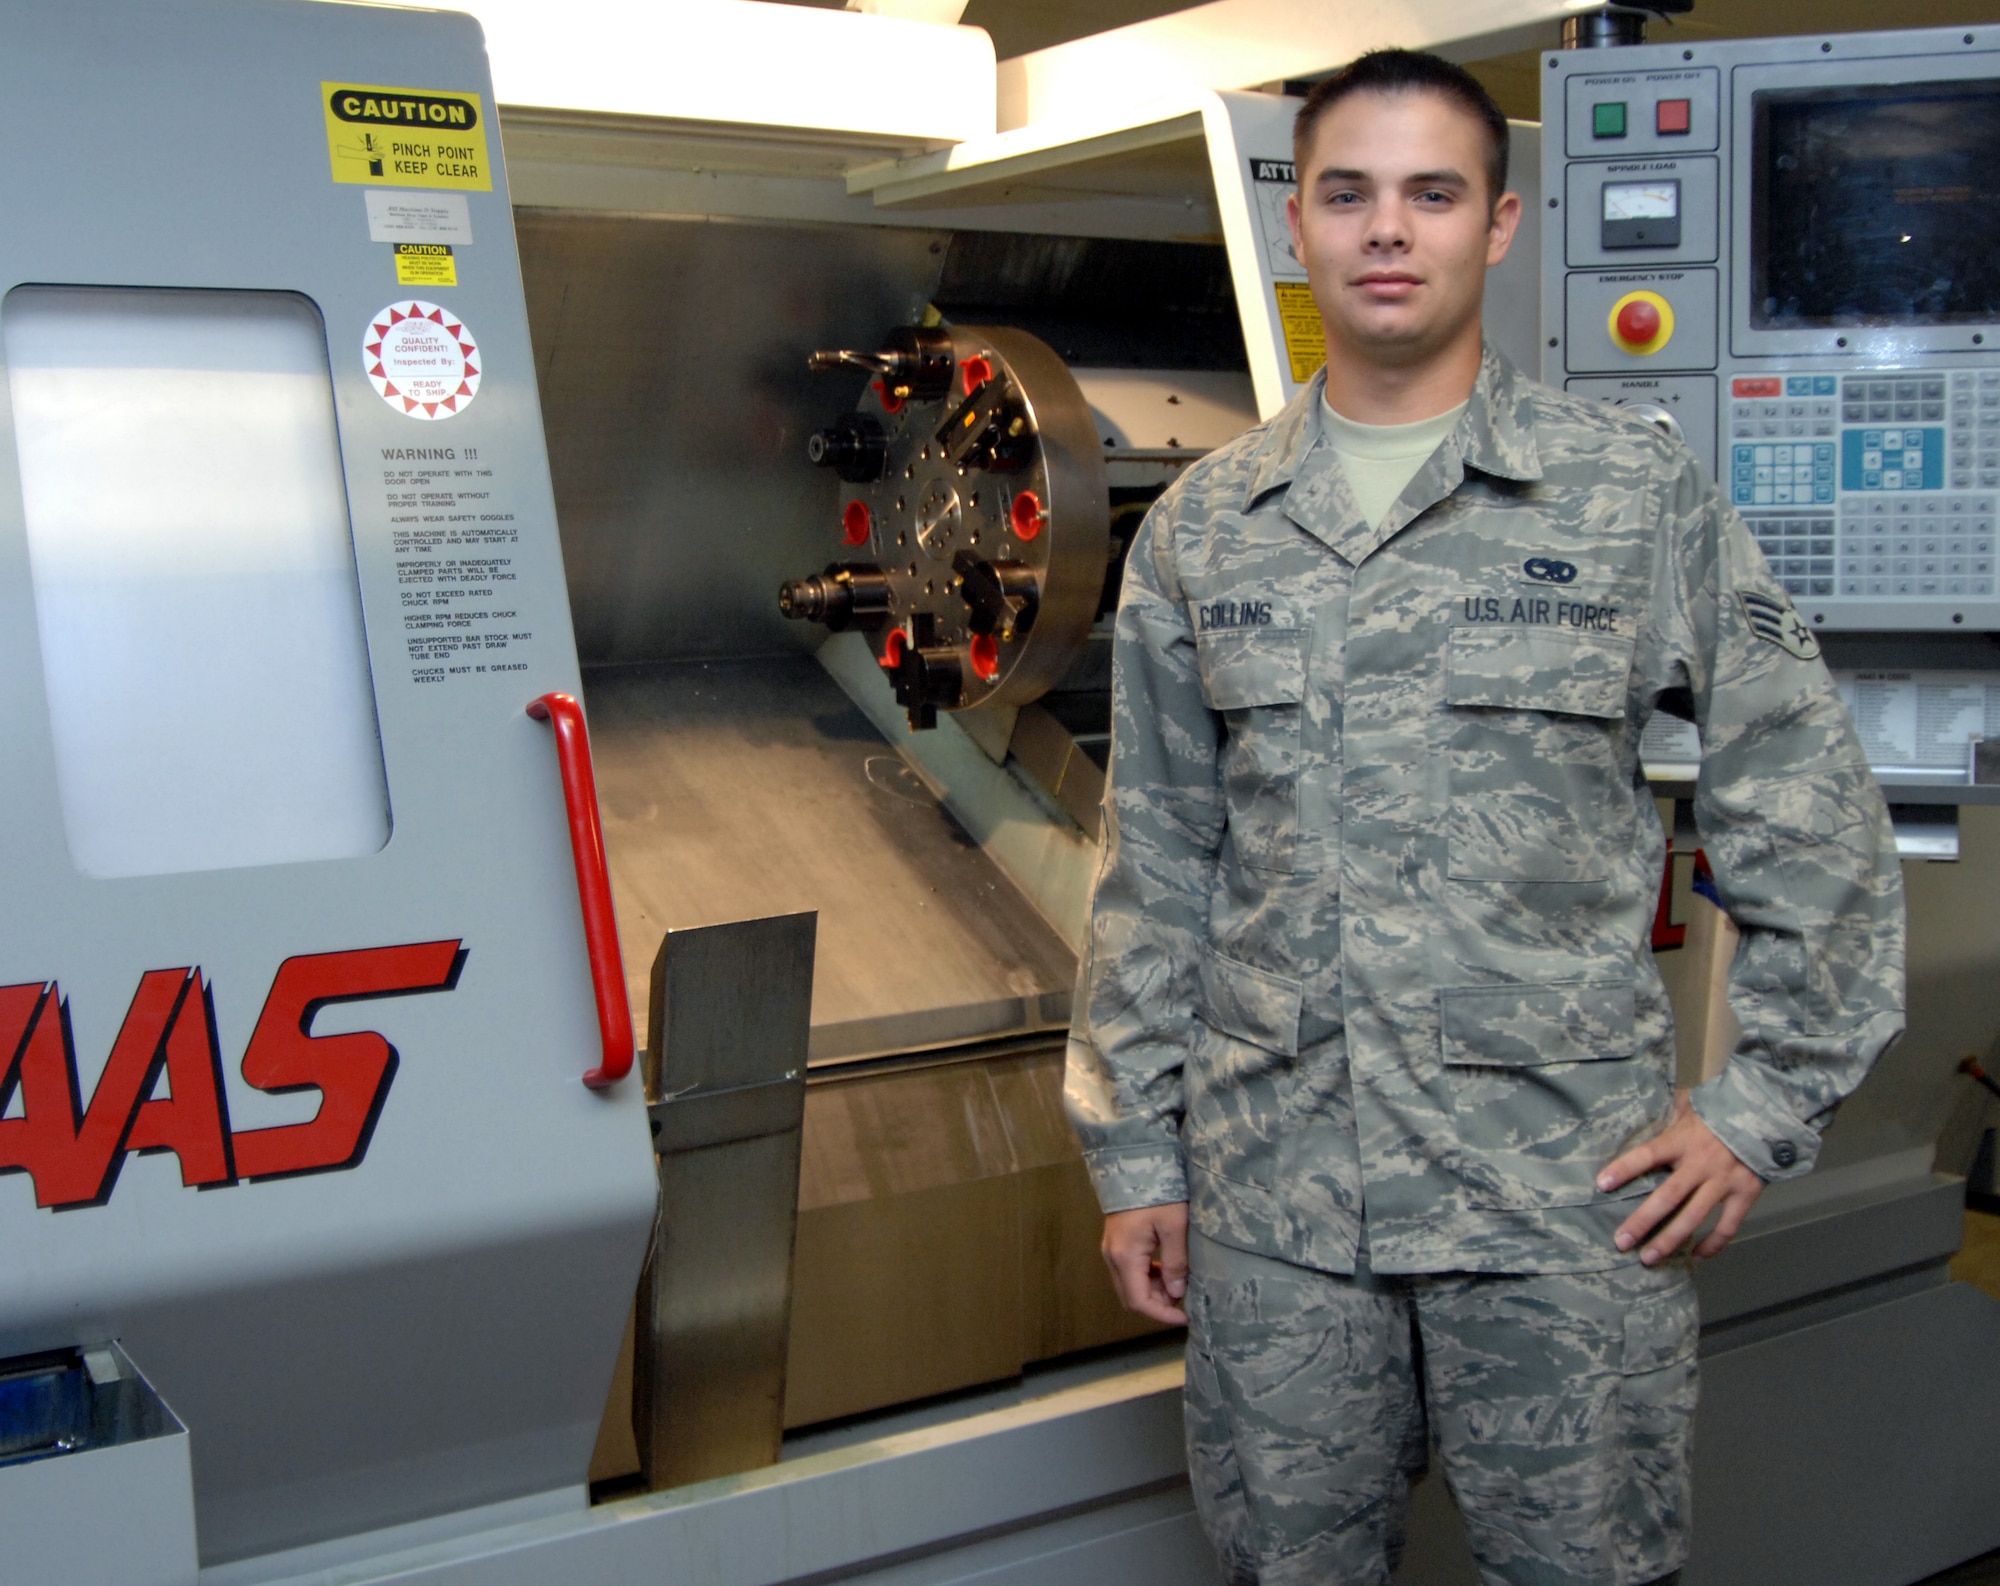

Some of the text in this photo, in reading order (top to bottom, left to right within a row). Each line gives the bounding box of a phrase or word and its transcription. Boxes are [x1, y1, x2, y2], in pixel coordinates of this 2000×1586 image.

[1585, 77, 1620, 85] POWER
[1646, 74, 1682, 82] POWER
[342, 97, 466, 124] CAUTION
[392, 142, 474, 161] PINCH POINT
[394, 160, 478, 178] KEEP CLEAR
[1258, 162, 1296, 181] ATT
[1607, 162, 1677, 172] SPINDLE LOAD
[400, 244, 446, 255] CAUTION
[1598, 275, 1656, 283] EMERGENCY
[394, 358, 436, 366] Inspected
[381, 448, 456, 460] WARNING
[461, 529, 518, 537] AUTOMATICALLY
[397, 561, 441, 569] IMPROPERLY
[404, 614, 432, 622] HIGHER
[1199, 601, 1273, 630] COLLINS
[1464, 596, 1620, 633] U.S. AIR FORCE
[407, 637, 462, 645] UNSUPPORTED
[428, 644, 459, 652] EXTEND
[412, 668, 445, 676] CHUCKS
[491, 664, 528, 672] GREASED
